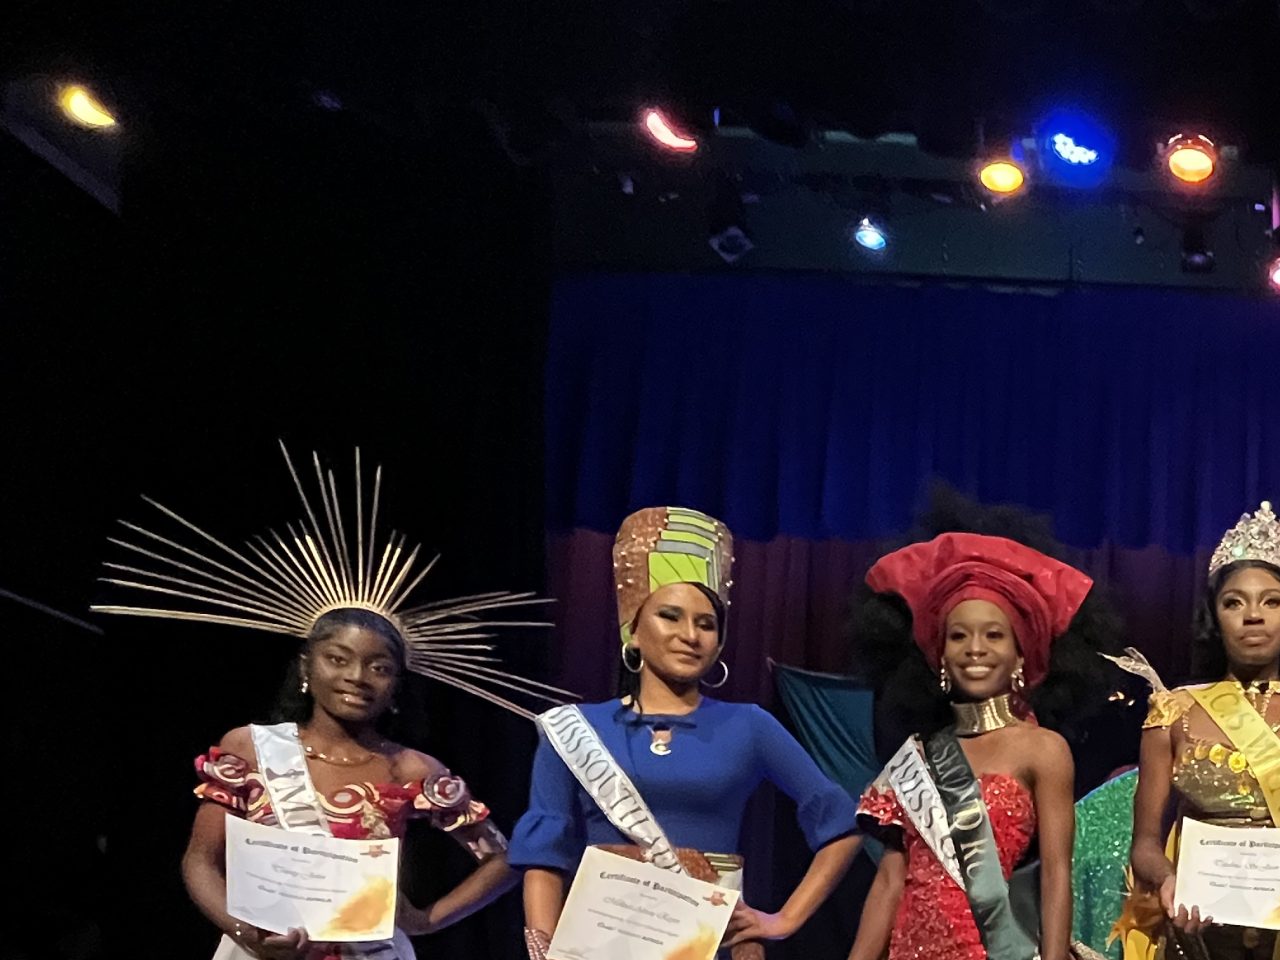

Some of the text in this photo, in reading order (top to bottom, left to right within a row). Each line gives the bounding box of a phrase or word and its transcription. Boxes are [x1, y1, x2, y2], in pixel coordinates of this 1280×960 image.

[274, 782, 326, 837] MI
[576, 748, 650, 832] SOUTH
[895, 761, 944, 829] MISS
